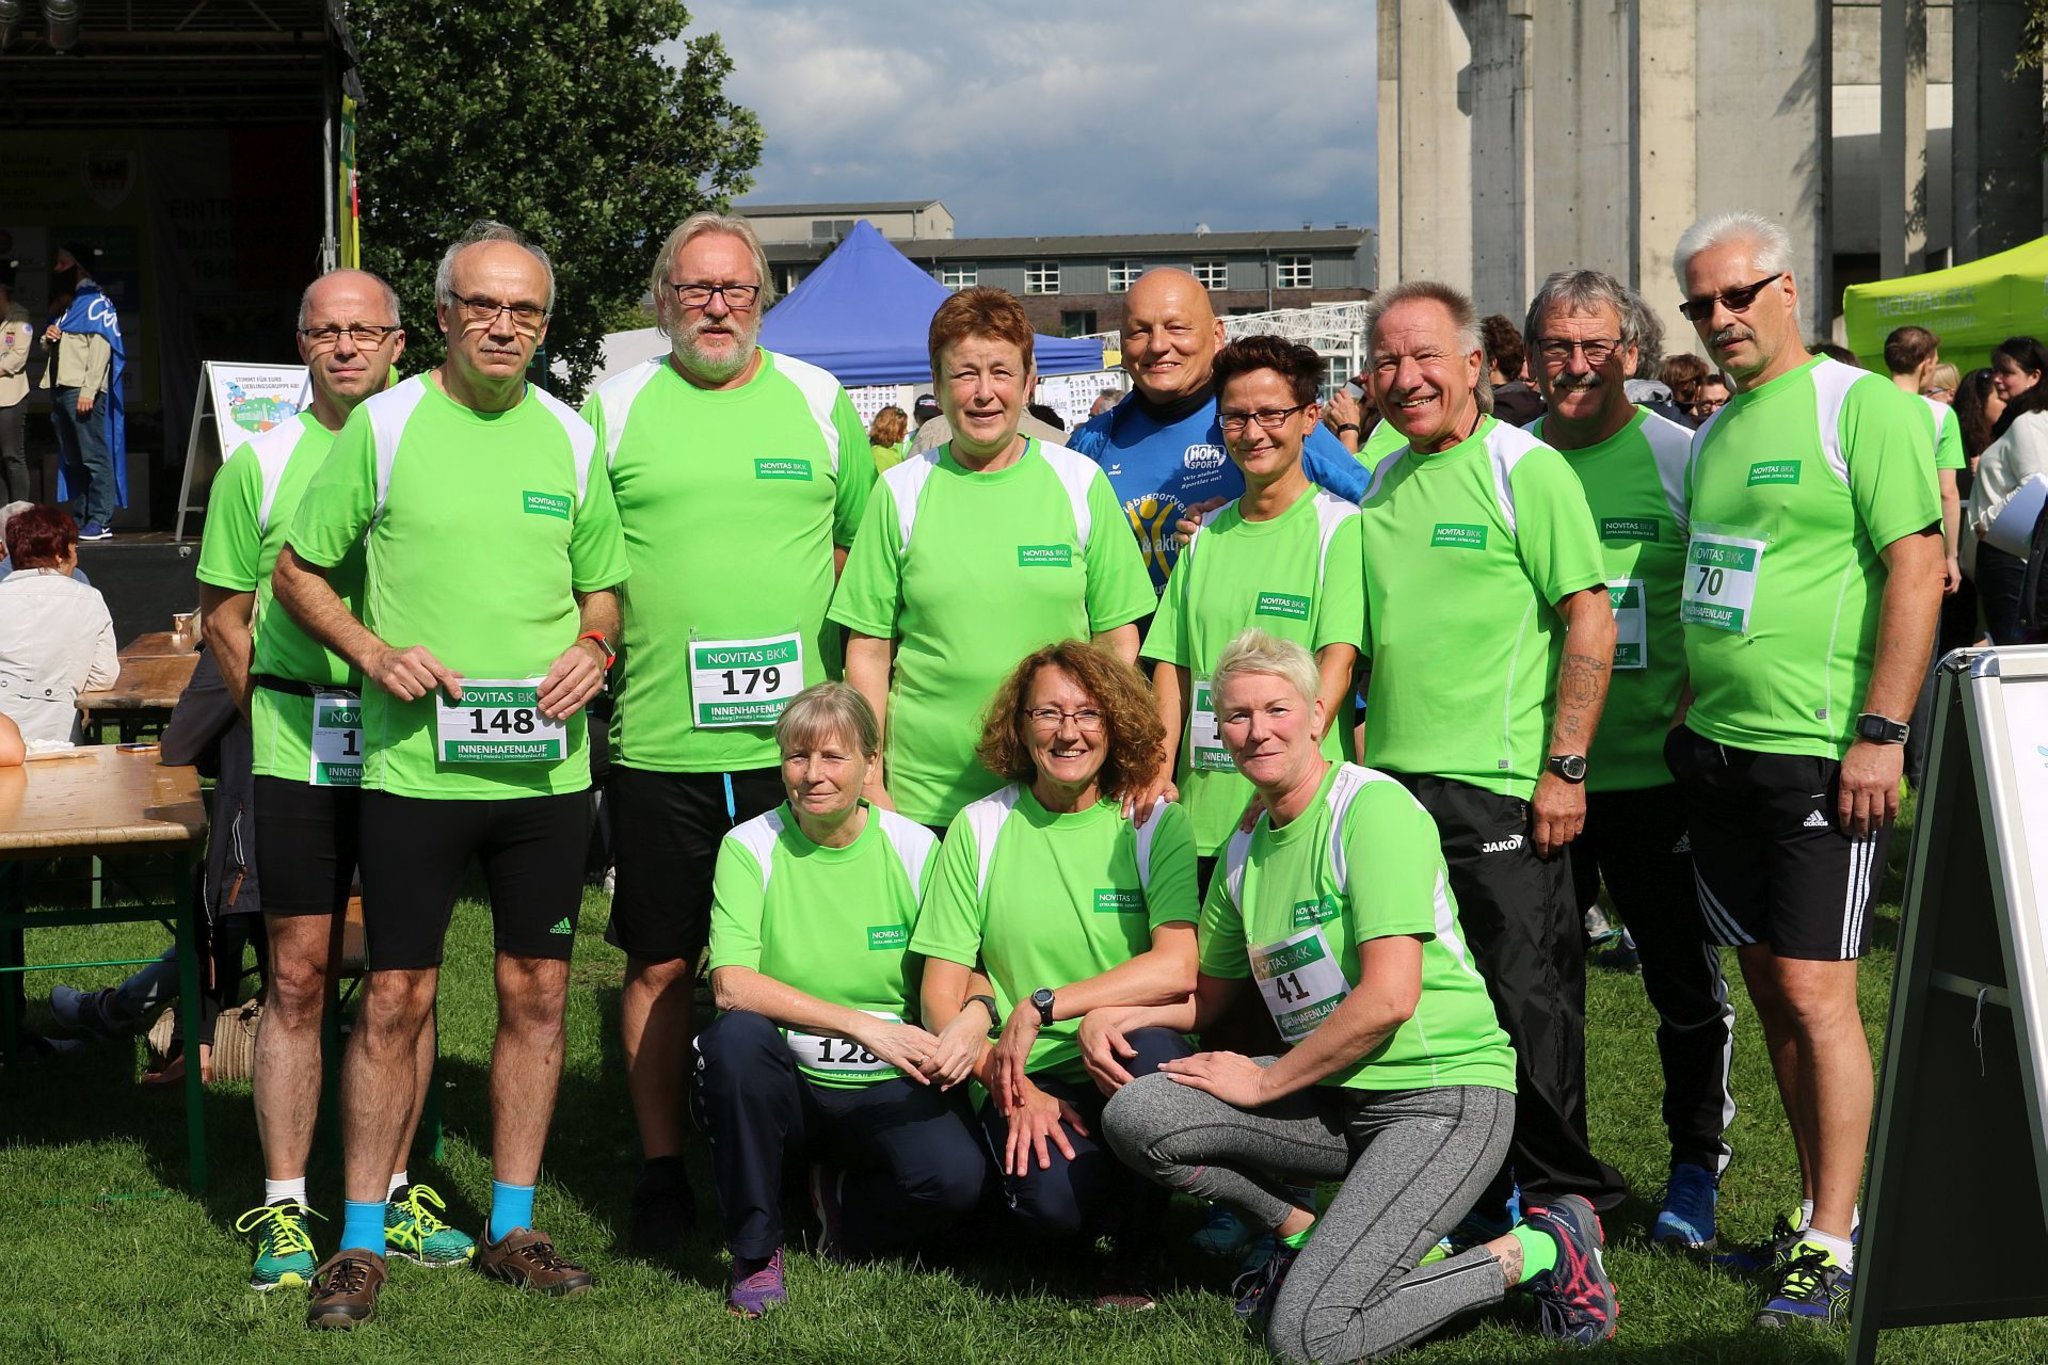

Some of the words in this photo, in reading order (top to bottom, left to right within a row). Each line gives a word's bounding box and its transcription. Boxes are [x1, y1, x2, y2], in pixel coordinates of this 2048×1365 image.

[760, 462, 792, 470] NOVITAS
[1190, 460, 1218, 469] SPORT
[1753, 465, 1779, 474] NOVITAS
[528, 496, 556, 506] NOVITAS
[1605, 522, 1639, 530] NOVITAS
[1437, 528, 1466, 536] NOVITAS
[1155, 533, 1181, 551] akt
[1696, 566, 1724, 596] 70
[1261, 597, 1290, 606] NOVITAS
[1609, 592, 1626, 604] KK
[707, 651, 763, 664] NOVITAS
[766, 647, 788, 660] BKK
[722, 667, 780, 695] 179
[517, 692, 535, 702] BK
[711, 702, 787, 715] INNENHAFENLAU
[470, 709, 535, 734] 148
[457, 744, 548, 754] INNENHAFENLAUF
[1482, 840, 1518, 852] JAKO
[1099, 894, 1131, 902] NOVITAS
[872, 931, 899, 939] NOVITAS
[1276, 972, 1311, 1004] 41
